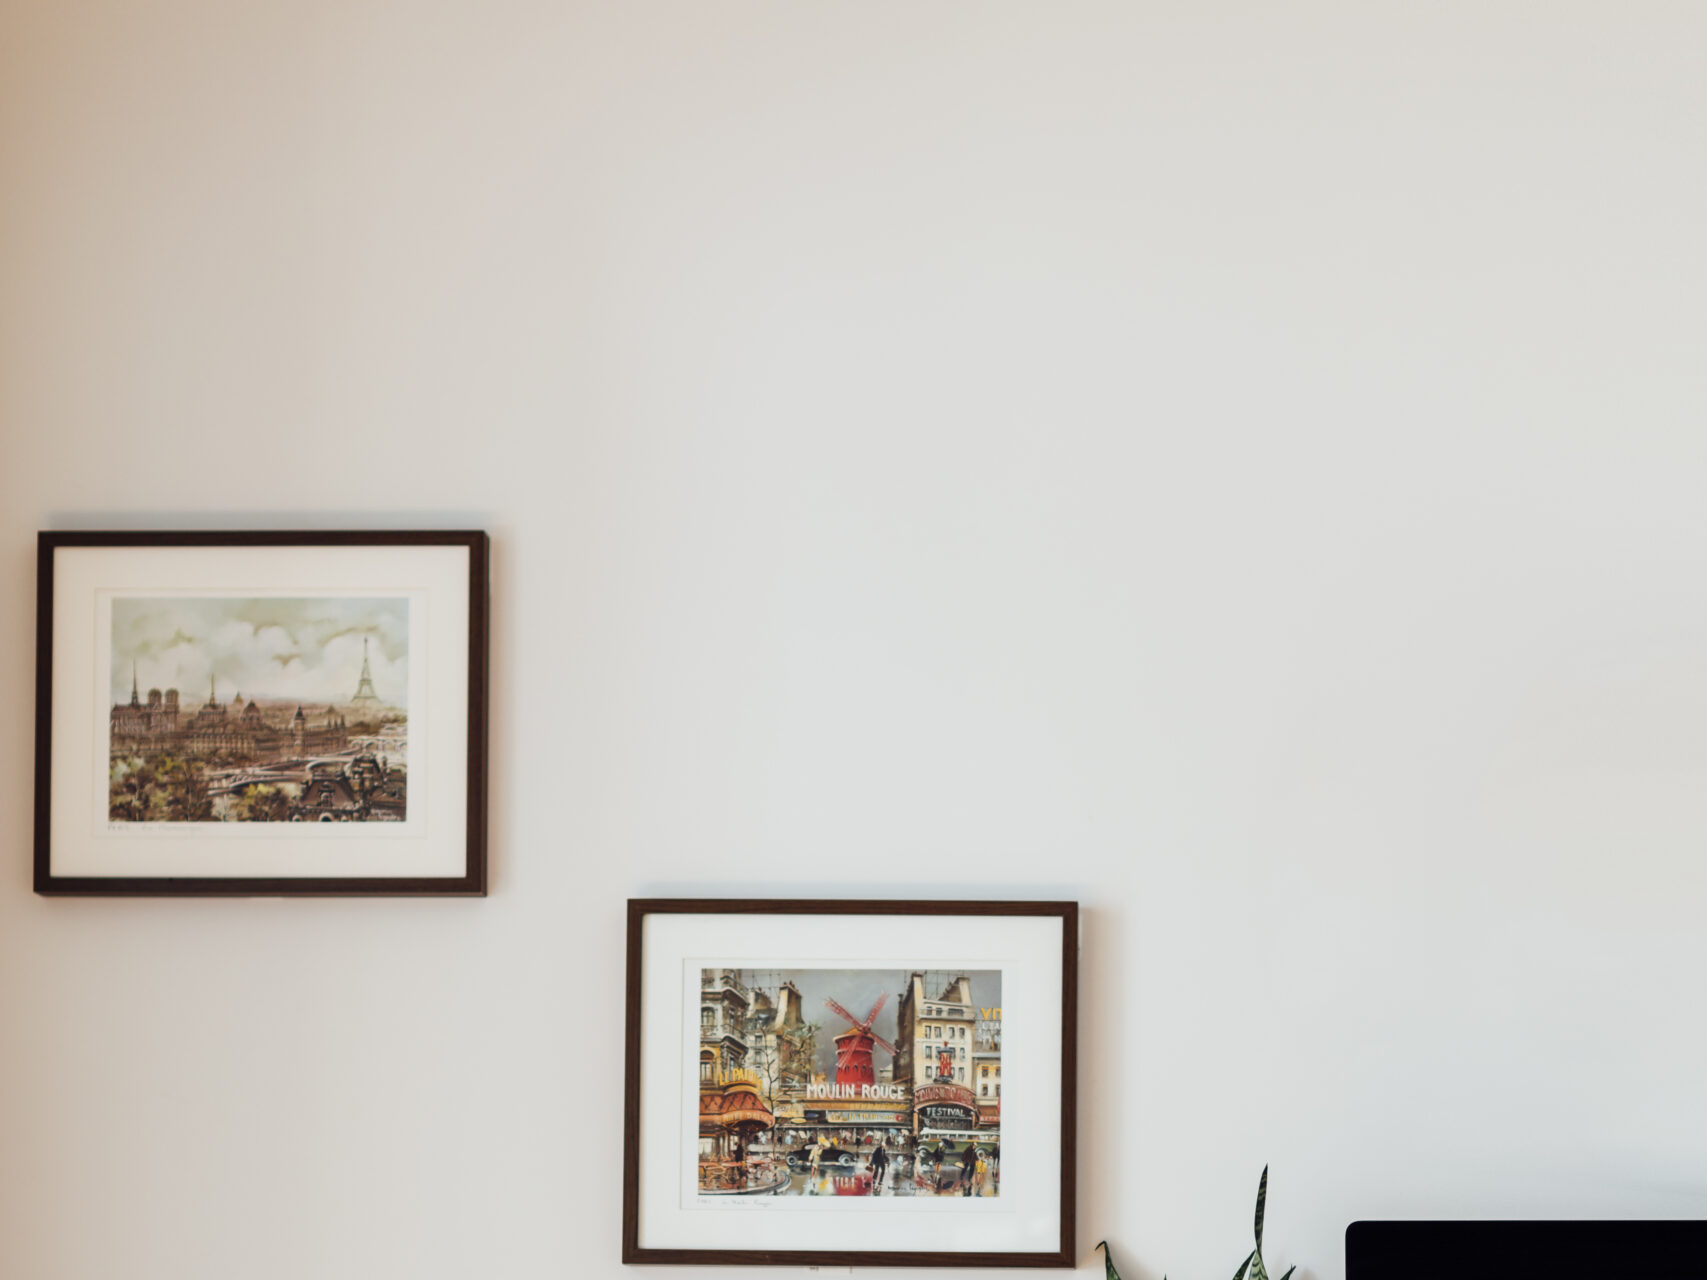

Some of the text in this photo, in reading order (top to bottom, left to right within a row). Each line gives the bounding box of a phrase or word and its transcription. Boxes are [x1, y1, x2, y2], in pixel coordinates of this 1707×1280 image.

[806, 1083, 905, 1100] MOULIN ROUGE
[926, 1107, 966, 1117] FESTIVAL
